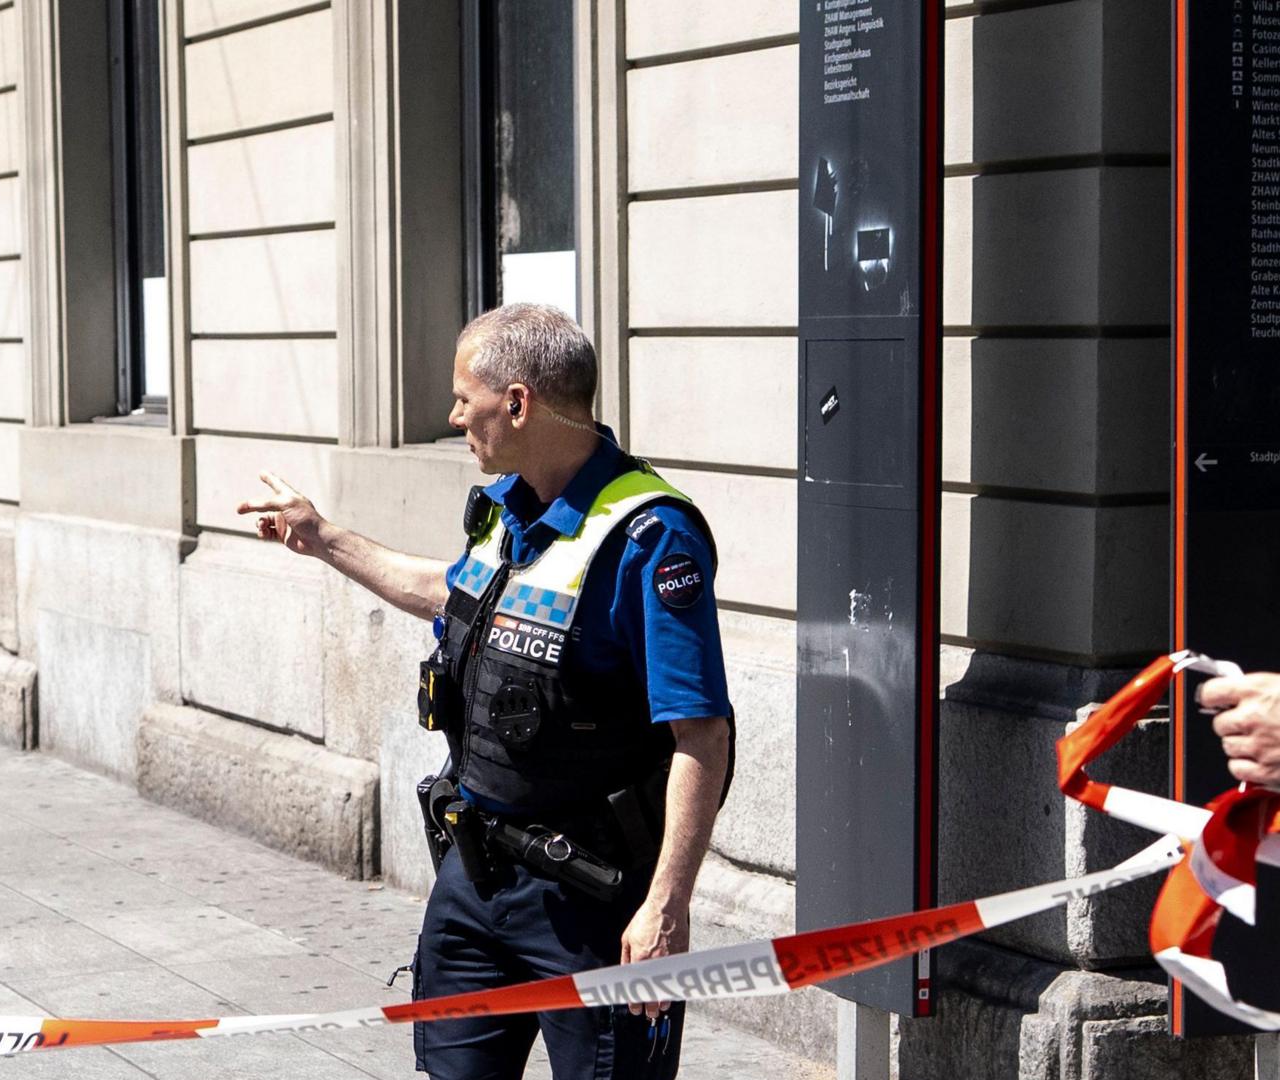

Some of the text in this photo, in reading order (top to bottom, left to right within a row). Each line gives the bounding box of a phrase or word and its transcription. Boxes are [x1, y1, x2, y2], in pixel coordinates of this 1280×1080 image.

[1252, 1, 1273, 12] Villa
[1251, 129, 1276, 140] Altes
[1251, 172, 1280, 182] ZHAW
[1251, 186, 1280, 197] ZHAW
[1251, 285, 1271, 296] Alte
[632, 516, 659, 539] POLICE
[658, 573, 701, 594] POLICE
[532, 627, 548, 638] CFF
[548, 631, 566, 642] FFS
[487, 627, 562, 663] POLICE
